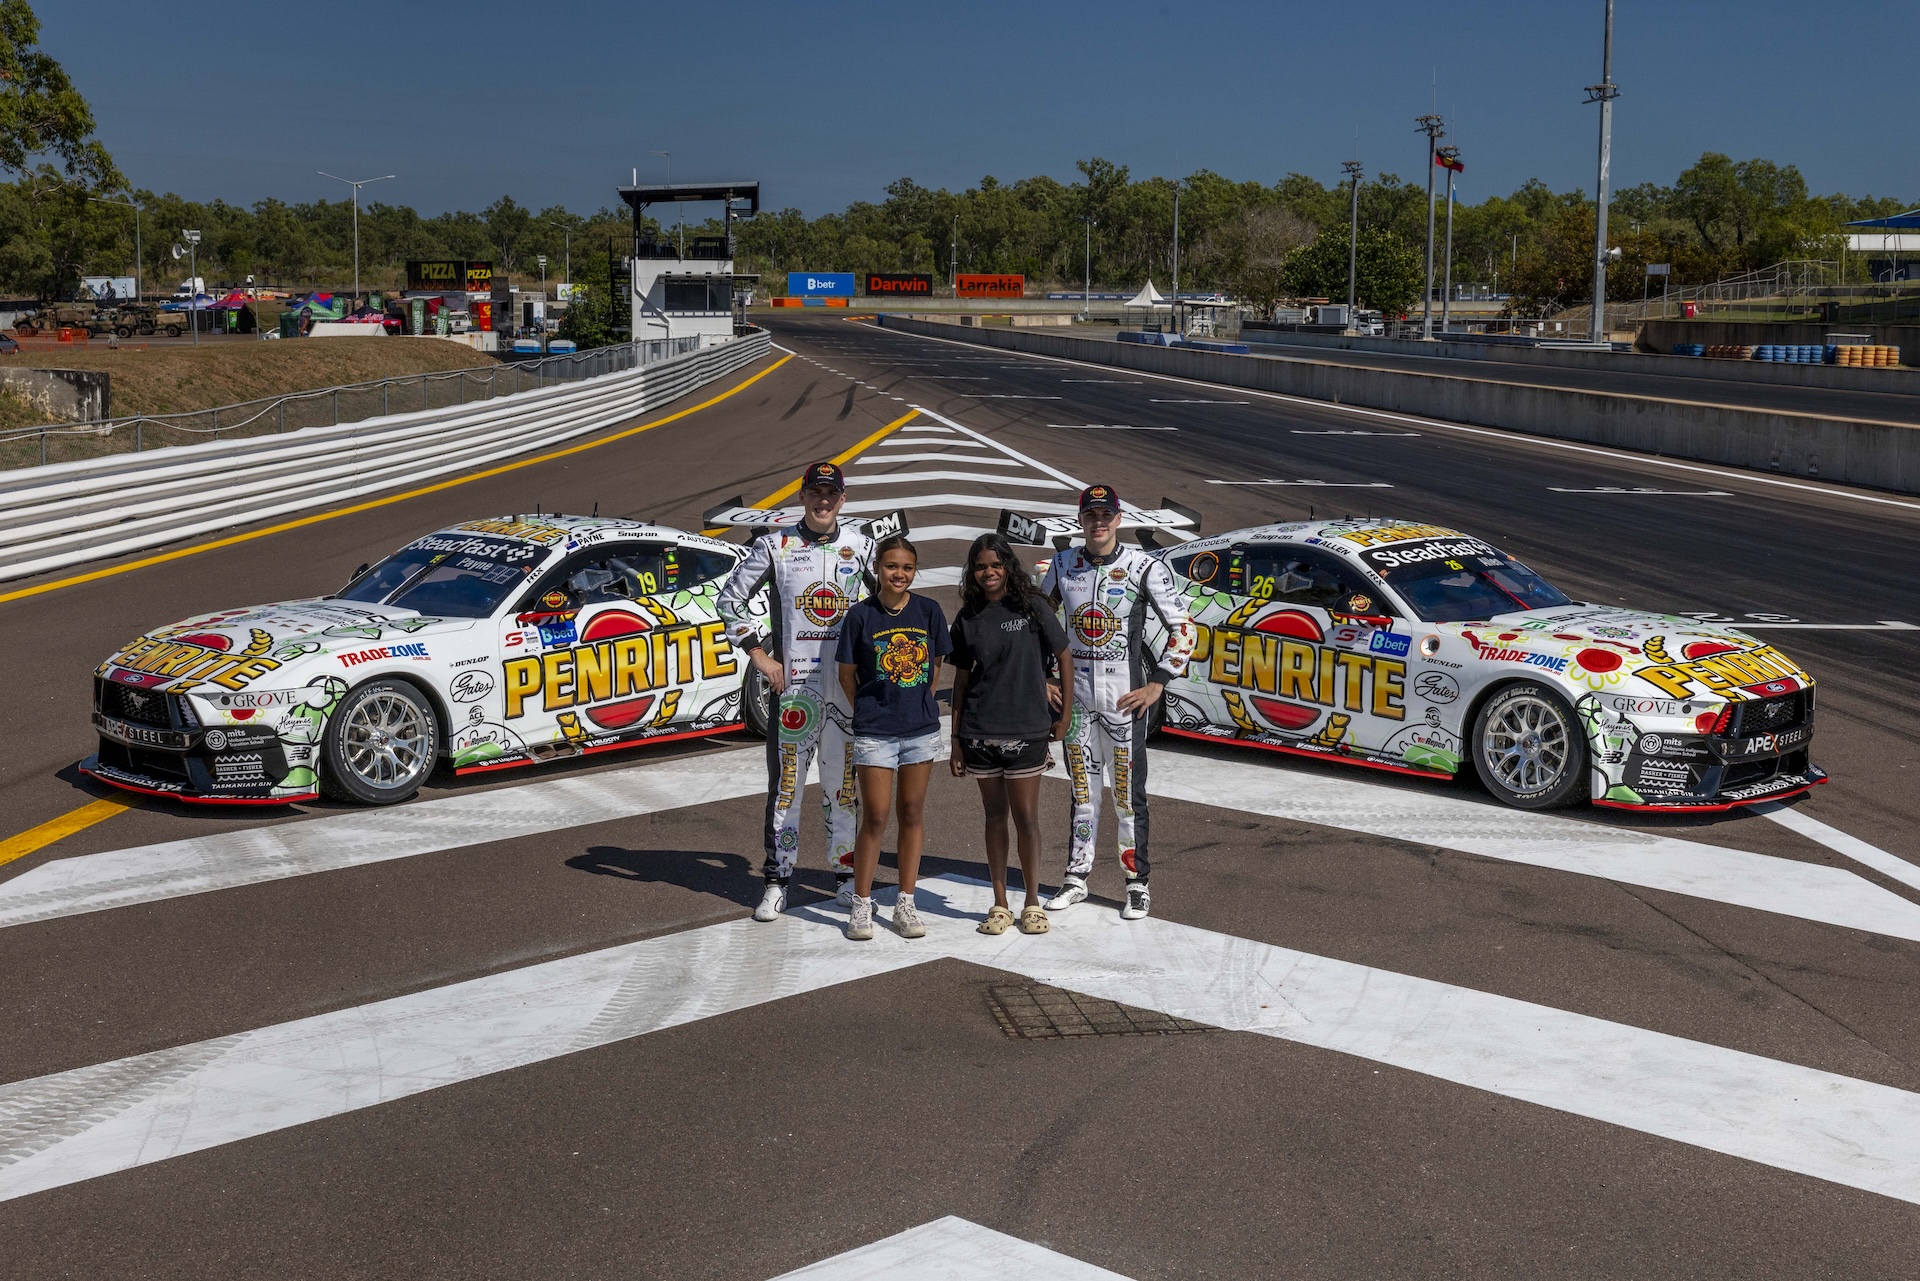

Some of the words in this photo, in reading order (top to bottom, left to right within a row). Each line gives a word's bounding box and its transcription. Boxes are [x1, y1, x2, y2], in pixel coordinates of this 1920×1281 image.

[421, 263, 457, 279] PIZZA
[467, 269, 493, 280] PIZZA
[817, 279, 836, 290] betr
[870, 276, 928, 292] Darwin
[959, 278, 1021, 293] Larrakia
[871, 512, 901, 540] D&M
[1008, 513, 1038, 541] D&M
[578, 533, 605, 546] PAYNE
[617, 531, 659, 539] Snap-on
[687, 536, 729, 547] AUTODESK
[1250, 533, 1293, 541] Snap-on
[408, 536, 511, 559] Steadfast
[1188, 537, 1232, 550] AUTODESK
[1319, 539, 1351, 556] ALLEN
[1371, 541, 1476, 568] Steadfast
[456, 557, 494, 572] Payne
[1136, 557, 1150, 573] HRX
[1444, 560, 1464, 571] 26
[526, 567, 544, 584] HRX
[636, 572, 657, 595] 19
[1366, 570, 1386, 586] HRX
[1250, 575, 1275, 599] 26
[542, 594, 568, 603] PENRITE
[795, 596, 850, 610] PENRITE
[1001, 618, 1028, 630] GOLDEN
[1069, 615, 1122, 631] PENRITE
[552, 628, 575, 640] betr
[1384, 637, 1408, 652] betr
[337, 643, 430, 668] TRADEZONE
[455, 655, 489, 668] DUNLOP
[1072, 649, 1104, 658] RACING
[1478, 646, 1569, 672] TRADEZONE
[502, 620, 738, 720] PENRITE
[1427, 657, 1463, 670] DUNLOP
[1538, 666, 1562, 676] .com.au
[452, 674, 491, 702] Gates
[1416, 674, 1458, 699] Gates
[1511, 687, 1539, 698] MAXX
[233, 690, 297, 708] GROVE
[1613, 697, 1676, 715] GROVE
[276, 715, 312, 732] Haymes
[469, 712, 485, 721] ACL
[1424, 713, 1441, 722] ACL
[104, 720, 127, 738] APEX
[129, 728, 164, 744] STEEL
[227, 729, 246, 738] mits
[1599, 717, 1632, 738] Haymes
[470, 735, 491, 746] Repco
[1425, 737, 1446, 749] Repco
[1663, 738, 1683, 746] mits
[1745, 732, 1779, 755] APEX
[1779, 730, 1802, 746] STEEL
[777, 743, 797, 811] PENRITE
[1067, 744, 1089, 806] PENRITE
[1114, 745, 1129, 809] PENRITE
